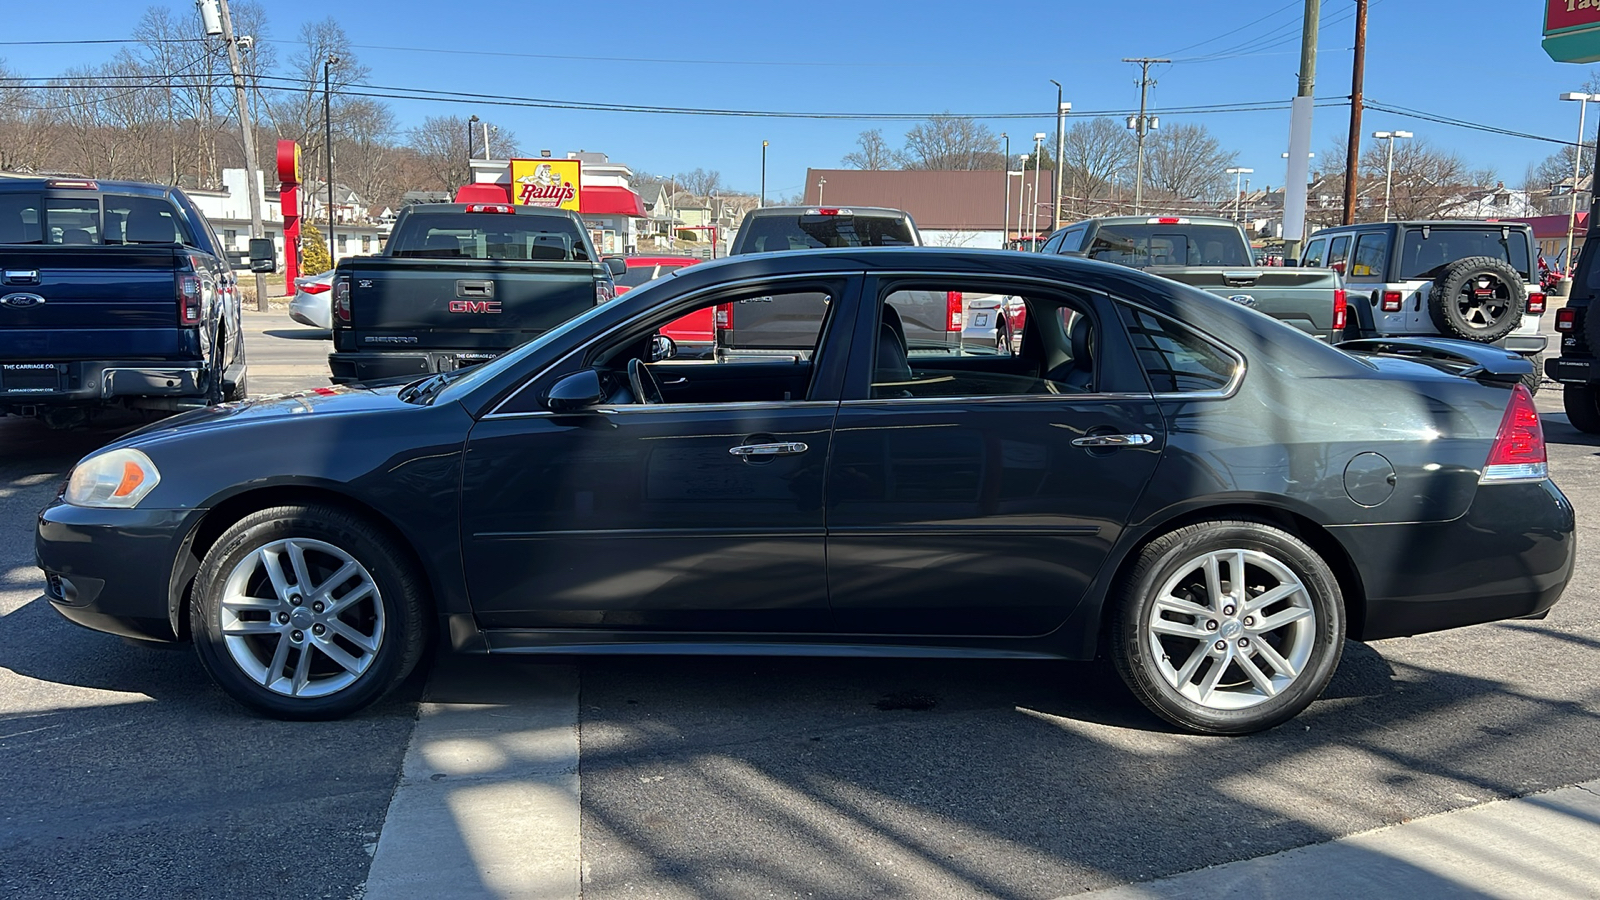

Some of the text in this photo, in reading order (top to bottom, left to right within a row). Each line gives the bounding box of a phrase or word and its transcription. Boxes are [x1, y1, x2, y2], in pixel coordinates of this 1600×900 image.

[519, 182, 574, 207] Rally's
[12, 296, 31, 305] Ford
[449, 301, 502, 313] GMC
